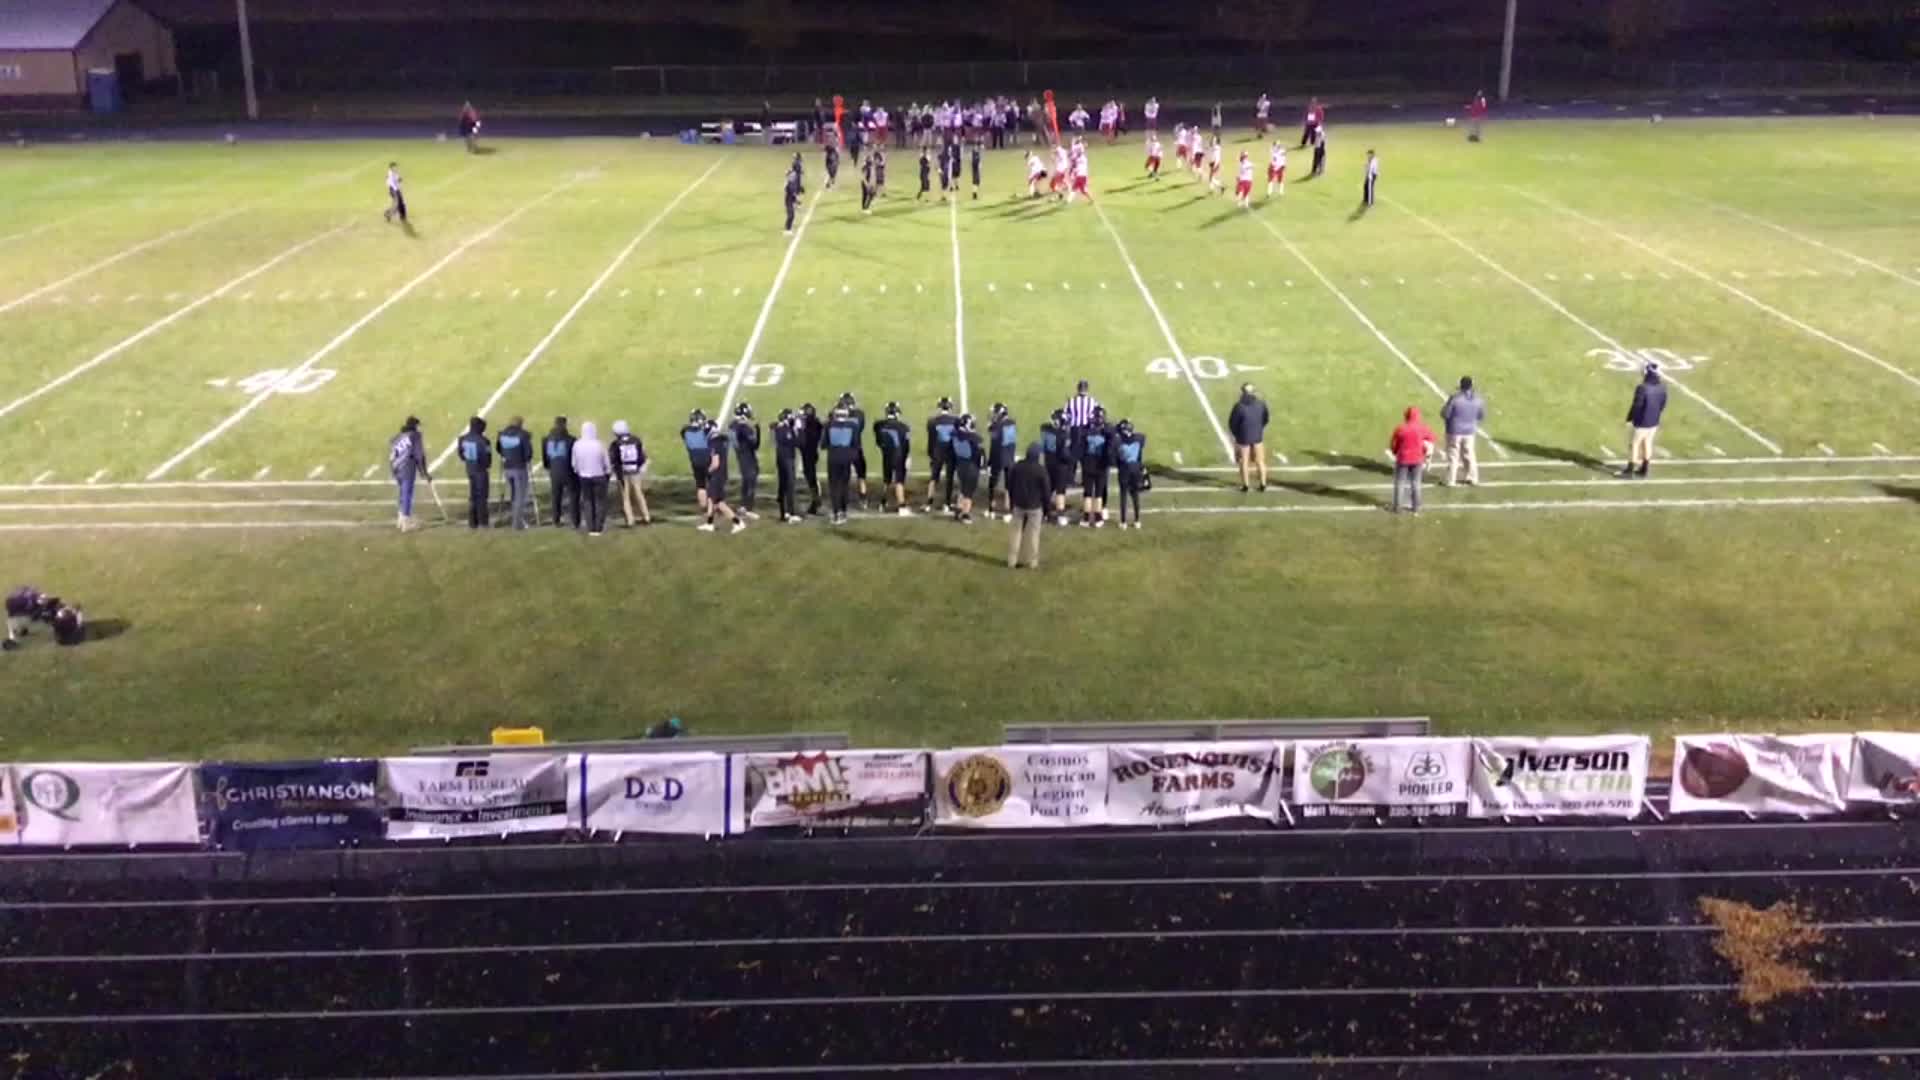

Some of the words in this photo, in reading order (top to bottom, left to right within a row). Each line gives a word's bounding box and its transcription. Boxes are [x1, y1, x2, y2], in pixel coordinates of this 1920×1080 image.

[1145, 356, 1230, 379] 40
[693, 364, 785, 388] 50
[1027, 755, 1089, 766] Cosmos
[1024, 771, 1096, 783] American
[1152, 772, 1235, 793] FARMS
[226, 782, 376, 801] CHRISTIANSON
[1033, 787, 1085, 801] Legion
[1399, 781, 1454, 796] PIONEER
[1031, 805, 1061, 817] Post
